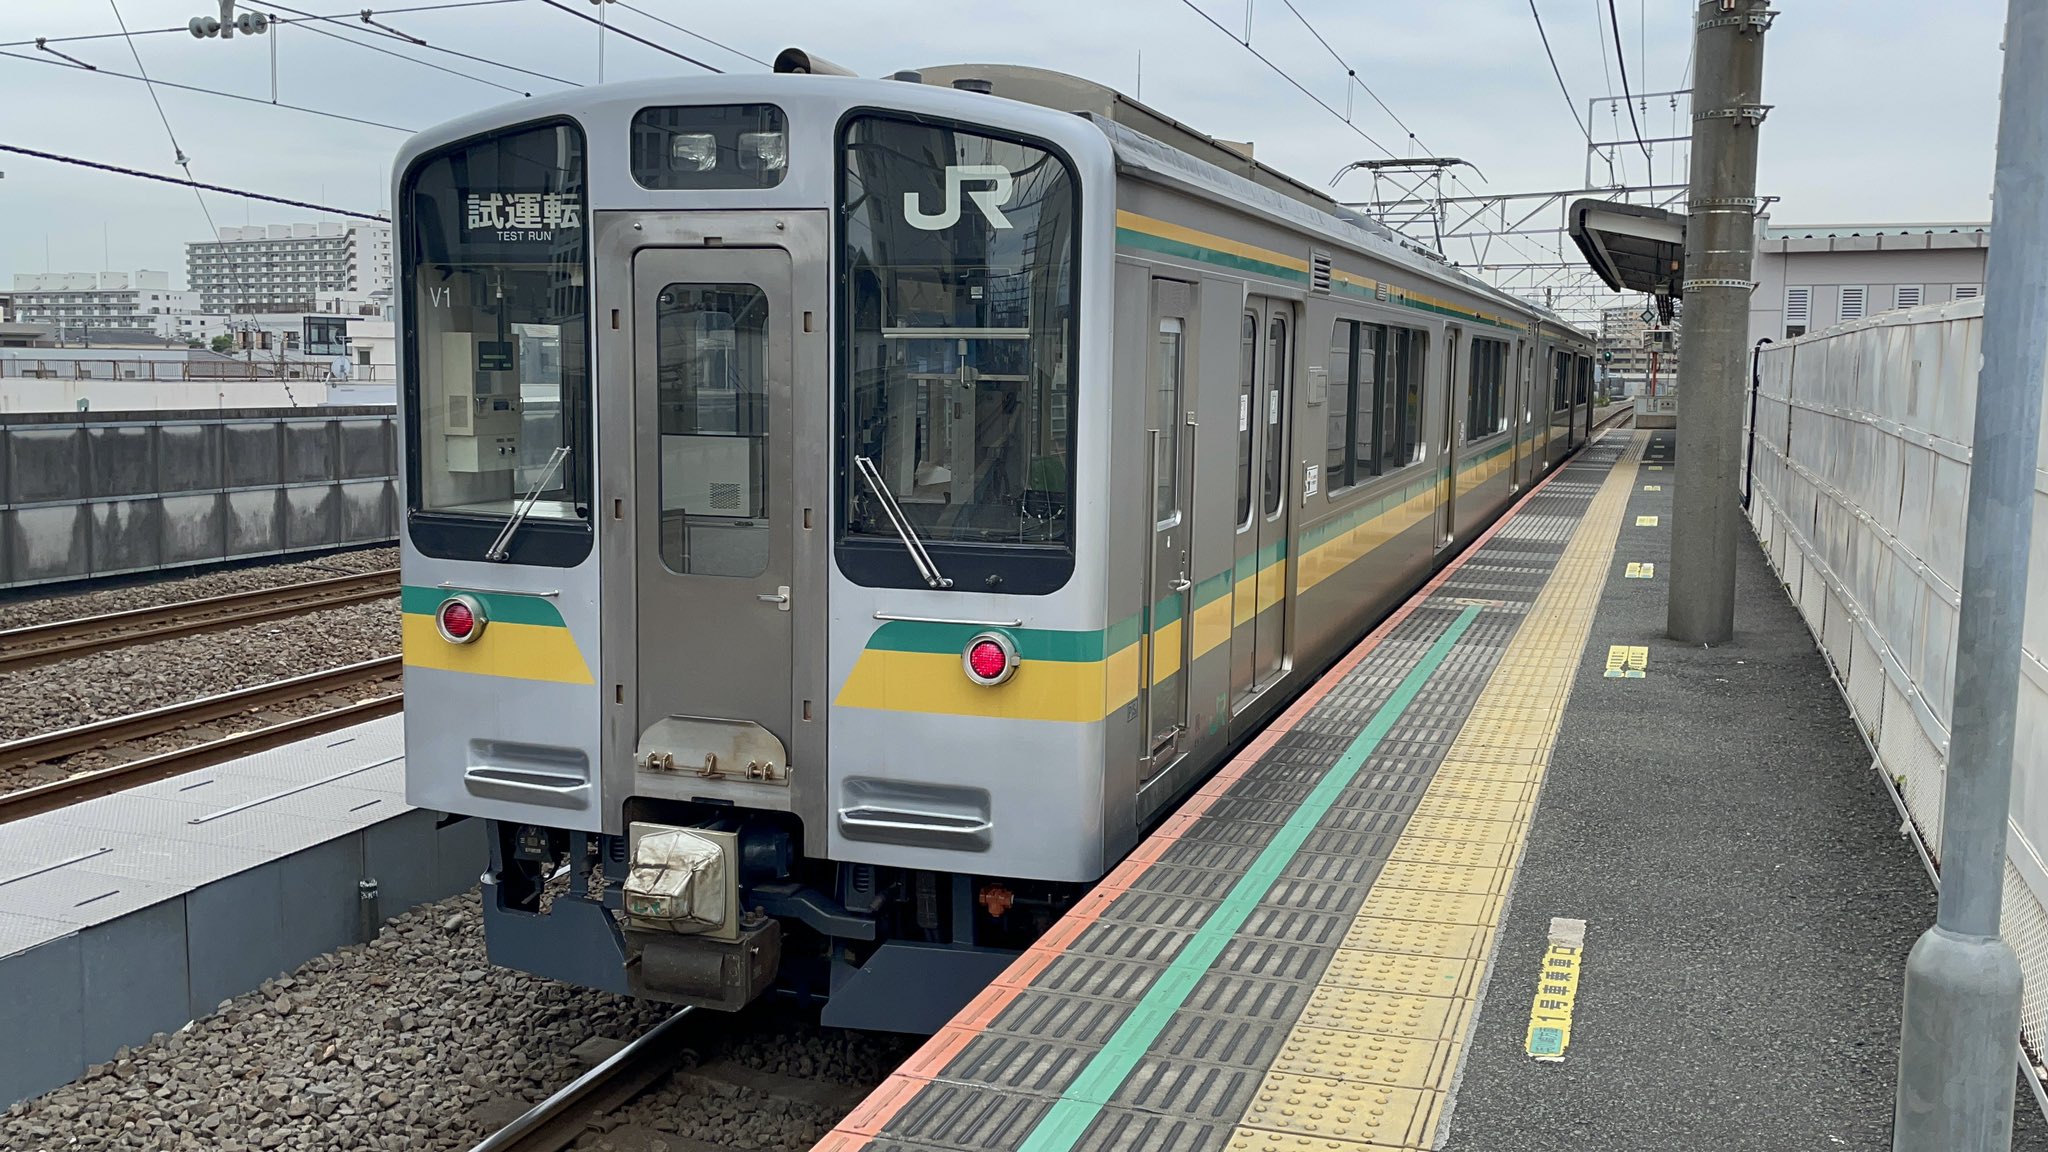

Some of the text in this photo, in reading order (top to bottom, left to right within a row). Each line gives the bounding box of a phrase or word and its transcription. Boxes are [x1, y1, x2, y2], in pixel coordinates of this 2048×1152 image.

[467, 192, 580, 230] 試運転
[904, 165, 1013, 230] JR
[497, 231, 552, 241] TEST RUN
[430, 287, 450, 308] V1
